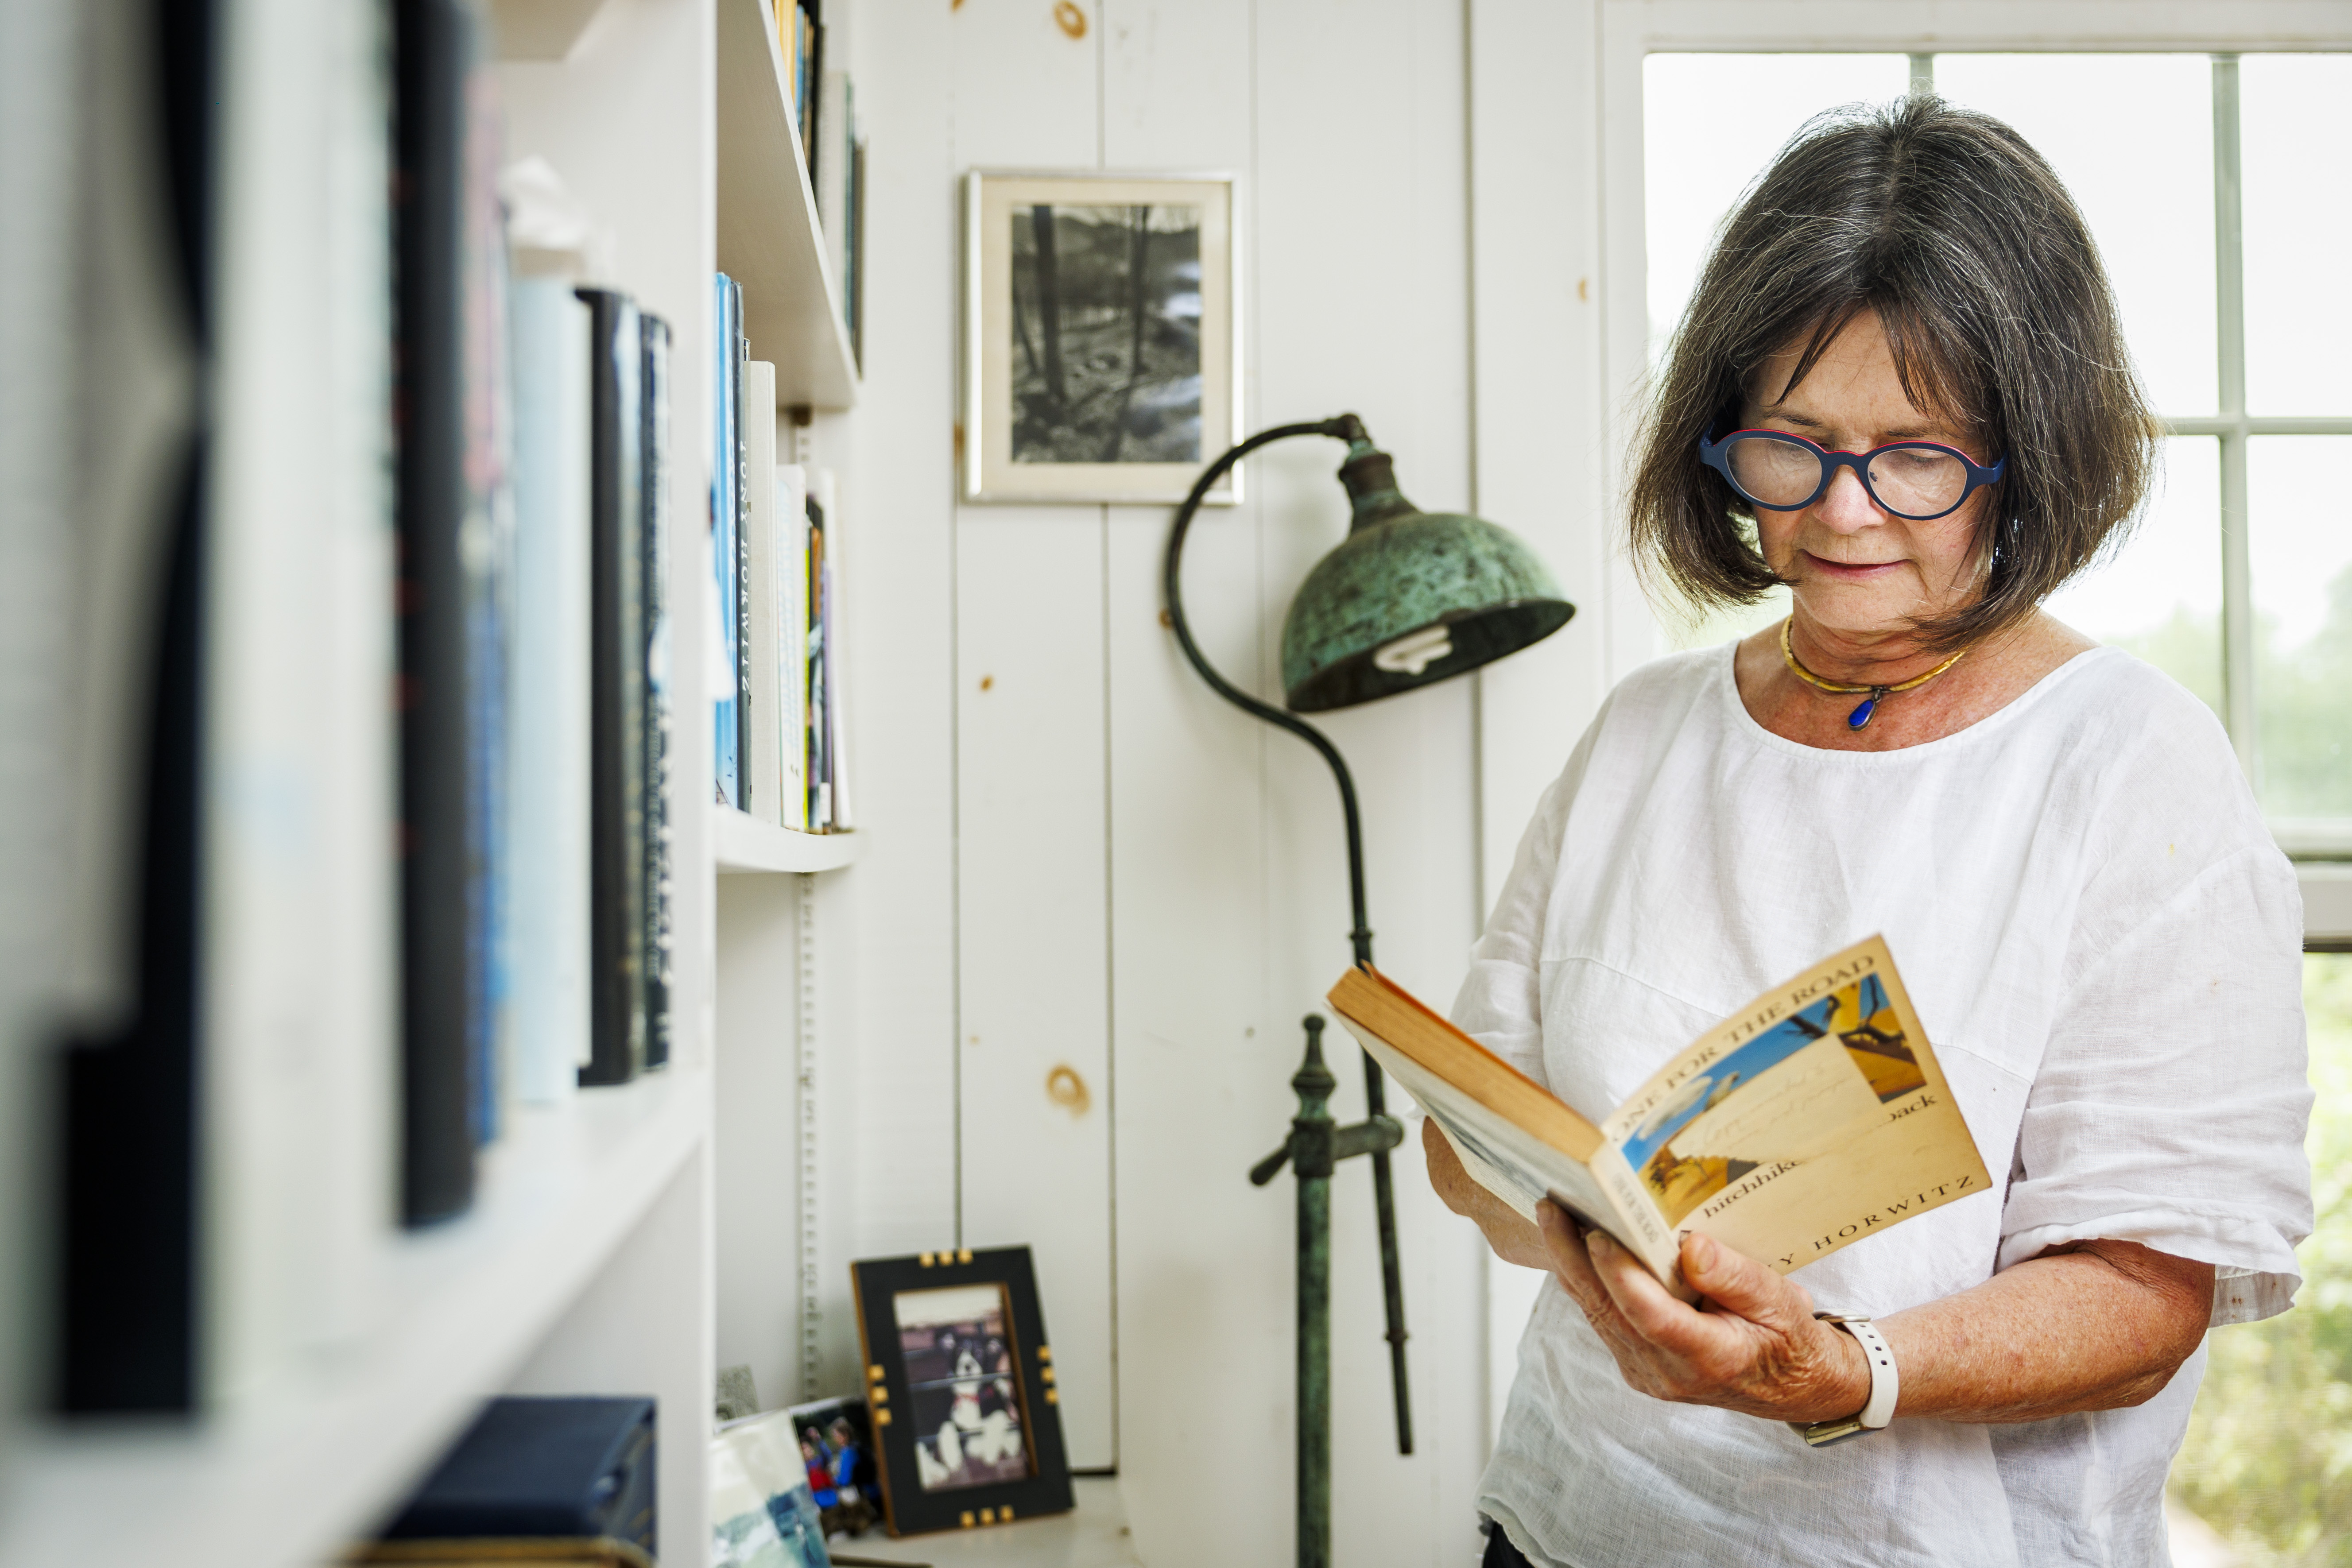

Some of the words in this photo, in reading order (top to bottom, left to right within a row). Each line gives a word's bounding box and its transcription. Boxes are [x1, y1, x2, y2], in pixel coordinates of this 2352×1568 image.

[741, 537, 749, 691] HORWITZ
[1612, 1089, 1662, 1142] ONE
[1666, 1046, 1717, 1090] FOR
[1722, 1001, 1786, 1044] THE
[1791, 955, 1875, 1006] ROAD
[1813, 1175, 1973, 1251] HORWITZ
